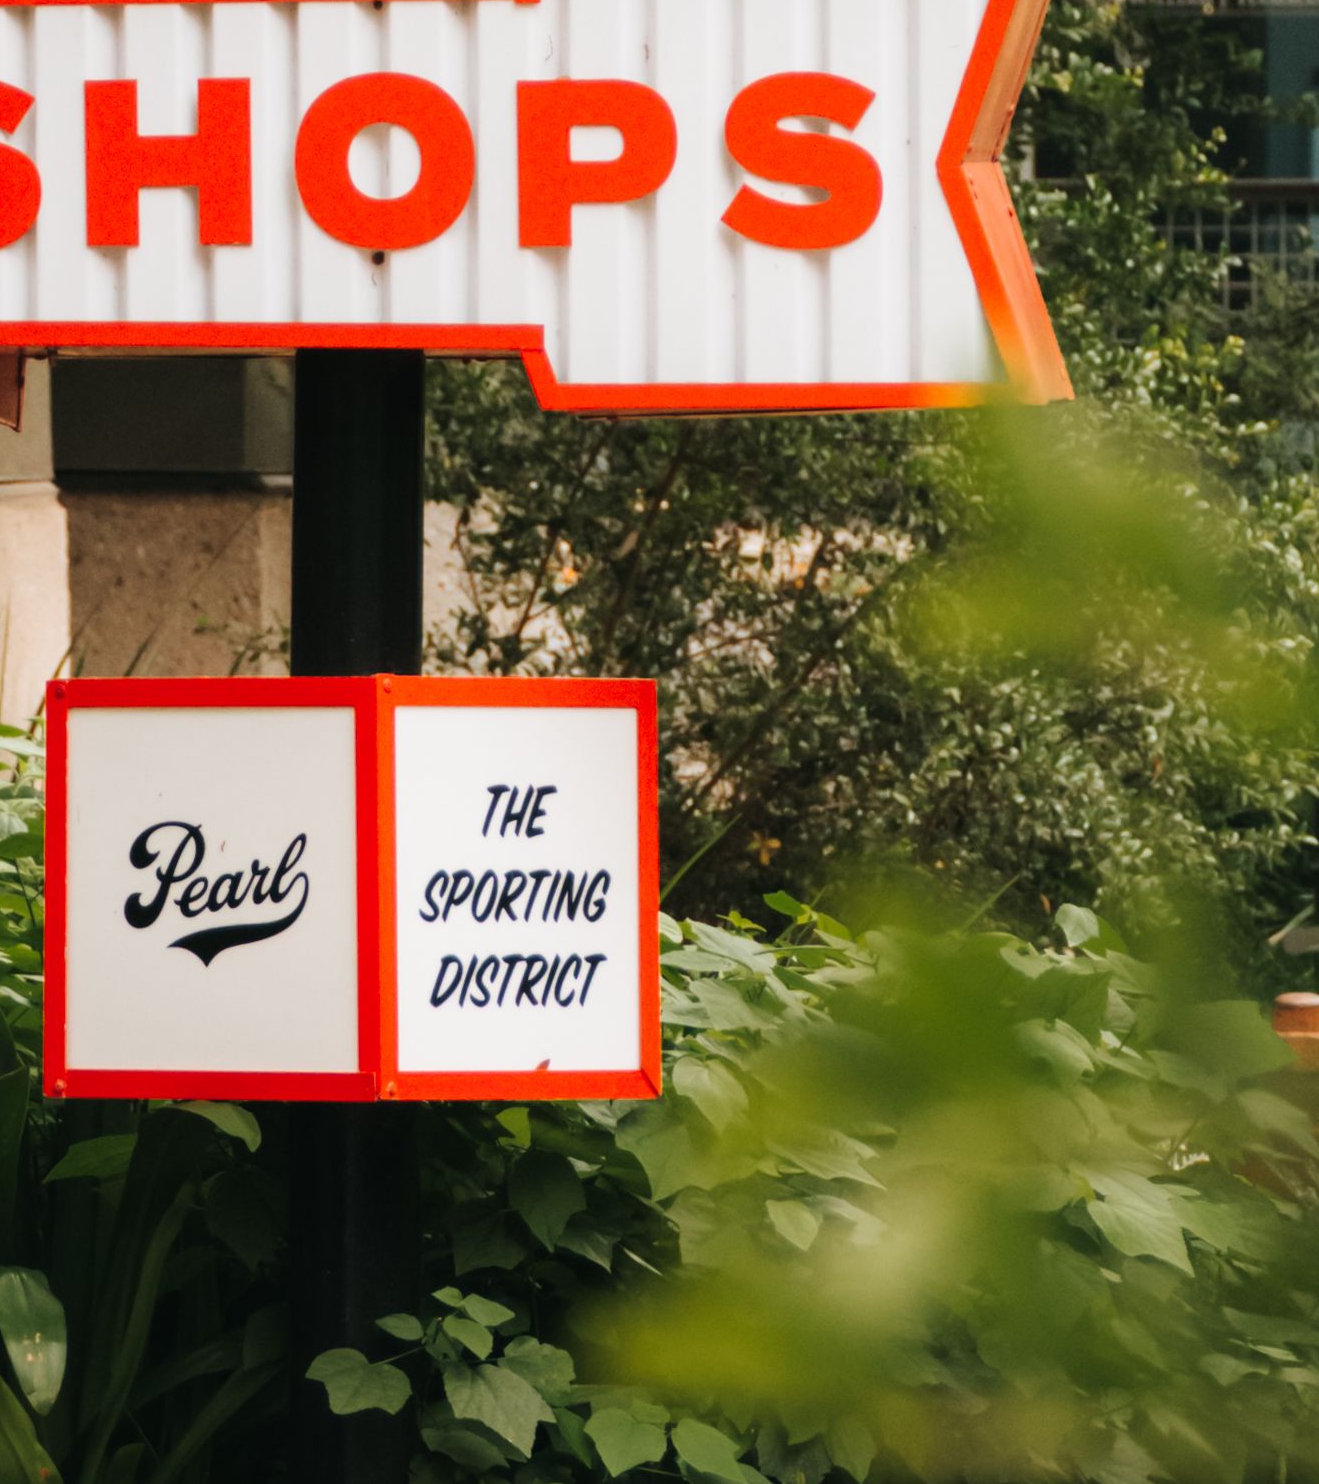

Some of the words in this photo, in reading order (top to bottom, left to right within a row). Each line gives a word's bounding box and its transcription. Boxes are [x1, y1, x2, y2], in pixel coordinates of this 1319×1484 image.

[482, 785, 557, 838] THE
[123, 821, 309, 967] Pearl
[419, 869, 611, 923] SPORTING
[430, 954, 607, 1008] DISTRICT
